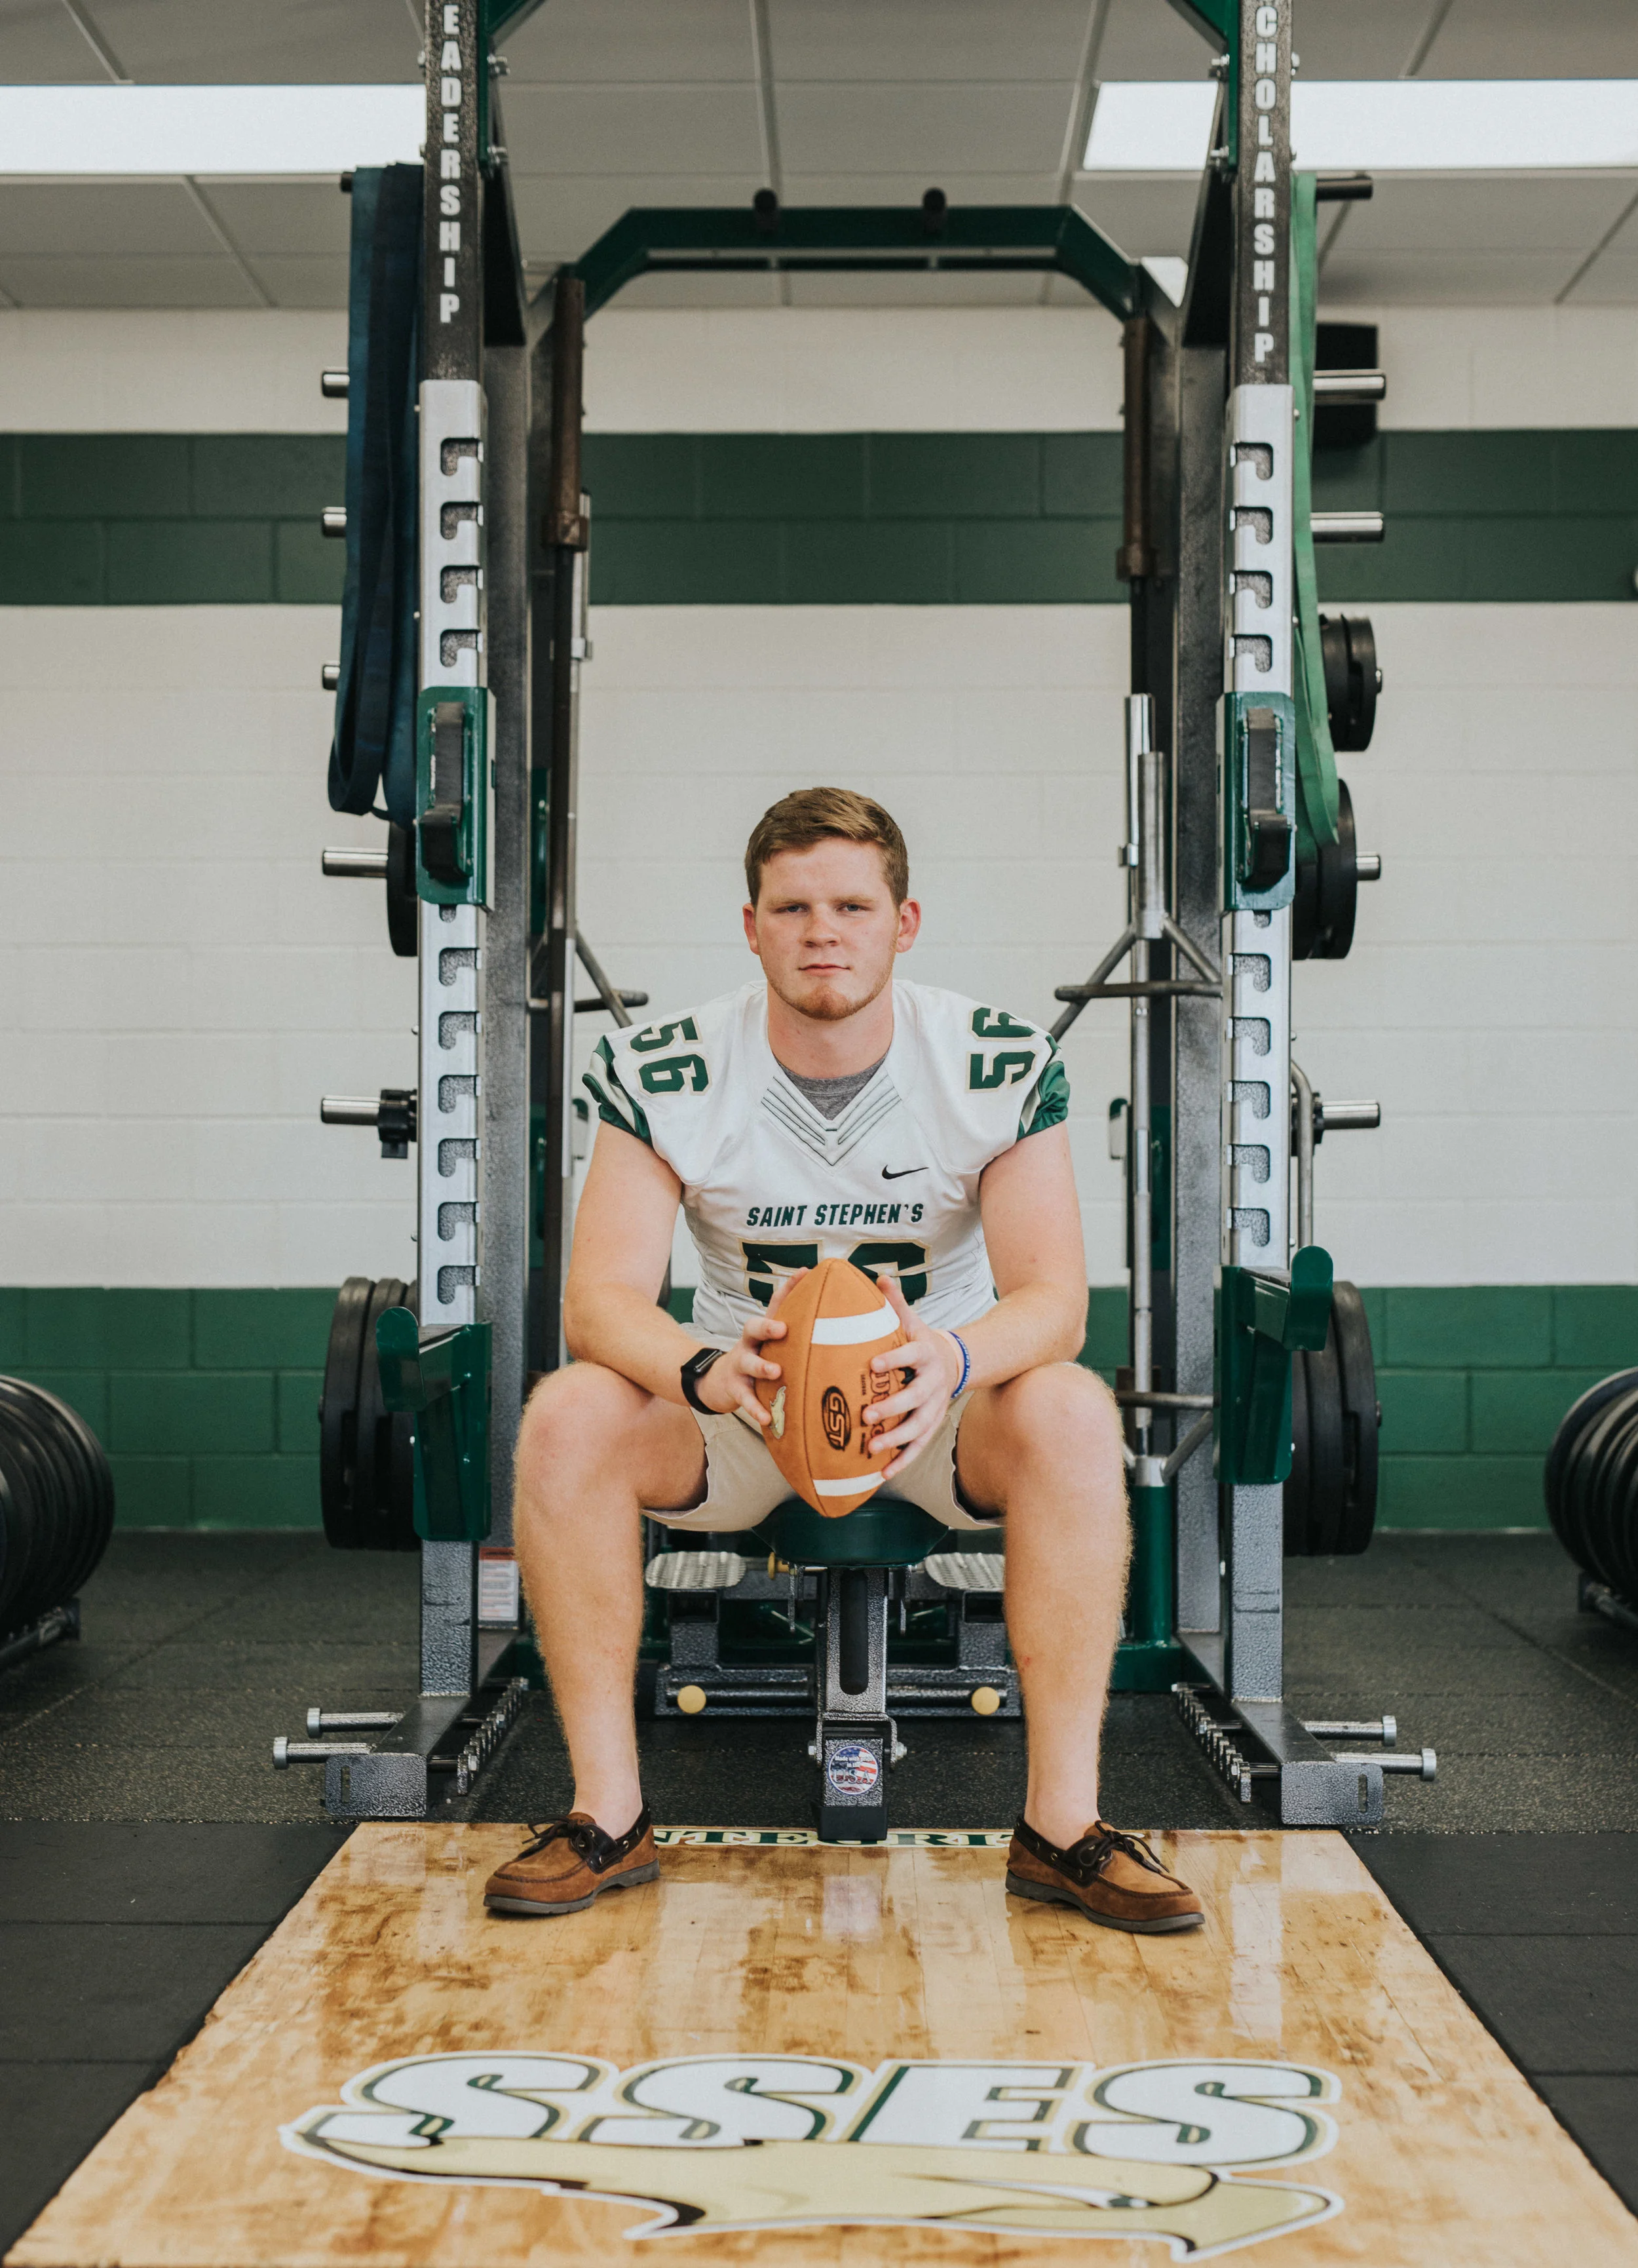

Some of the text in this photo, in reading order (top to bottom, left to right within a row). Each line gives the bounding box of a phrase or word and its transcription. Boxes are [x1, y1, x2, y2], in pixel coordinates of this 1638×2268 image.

[628, 1015, 713, 1098] 56
[965, 1005, 1038, 1093] 56
[746, 1203, 924, 1227] SAINT STEPHEN'S
[828, 1392, 845, 1447] GST
[832, 1769, 872, 1784] USA
[285, 2052, 1341, 2166] SSES
